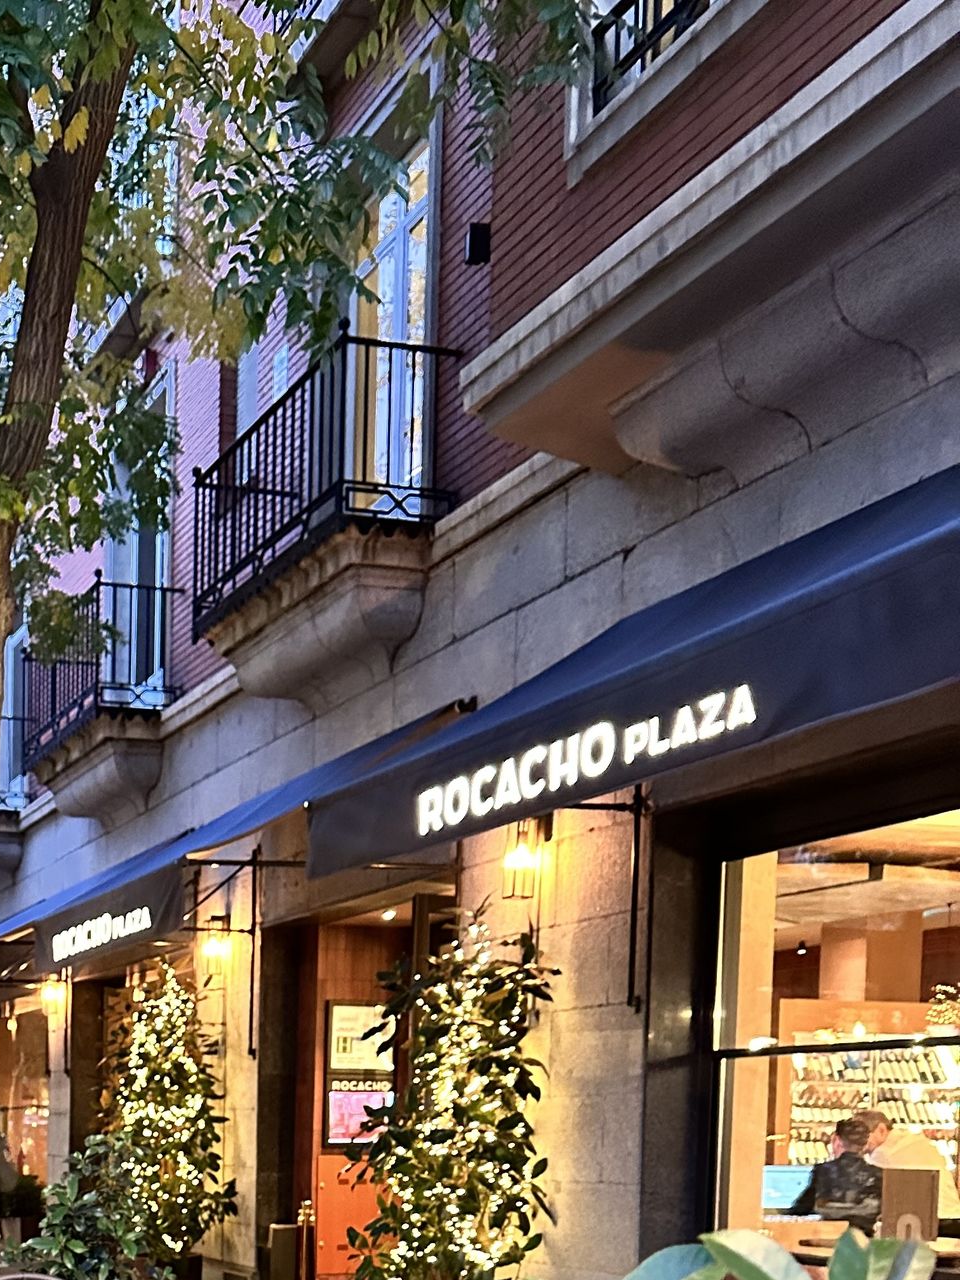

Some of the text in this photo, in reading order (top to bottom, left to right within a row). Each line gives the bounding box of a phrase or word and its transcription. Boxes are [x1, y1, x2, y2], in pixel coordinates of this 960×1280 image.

[416, 684, 757, 837] ROCACHO PLAZA
[331, 1080, 392, 1091] ROCACHO
